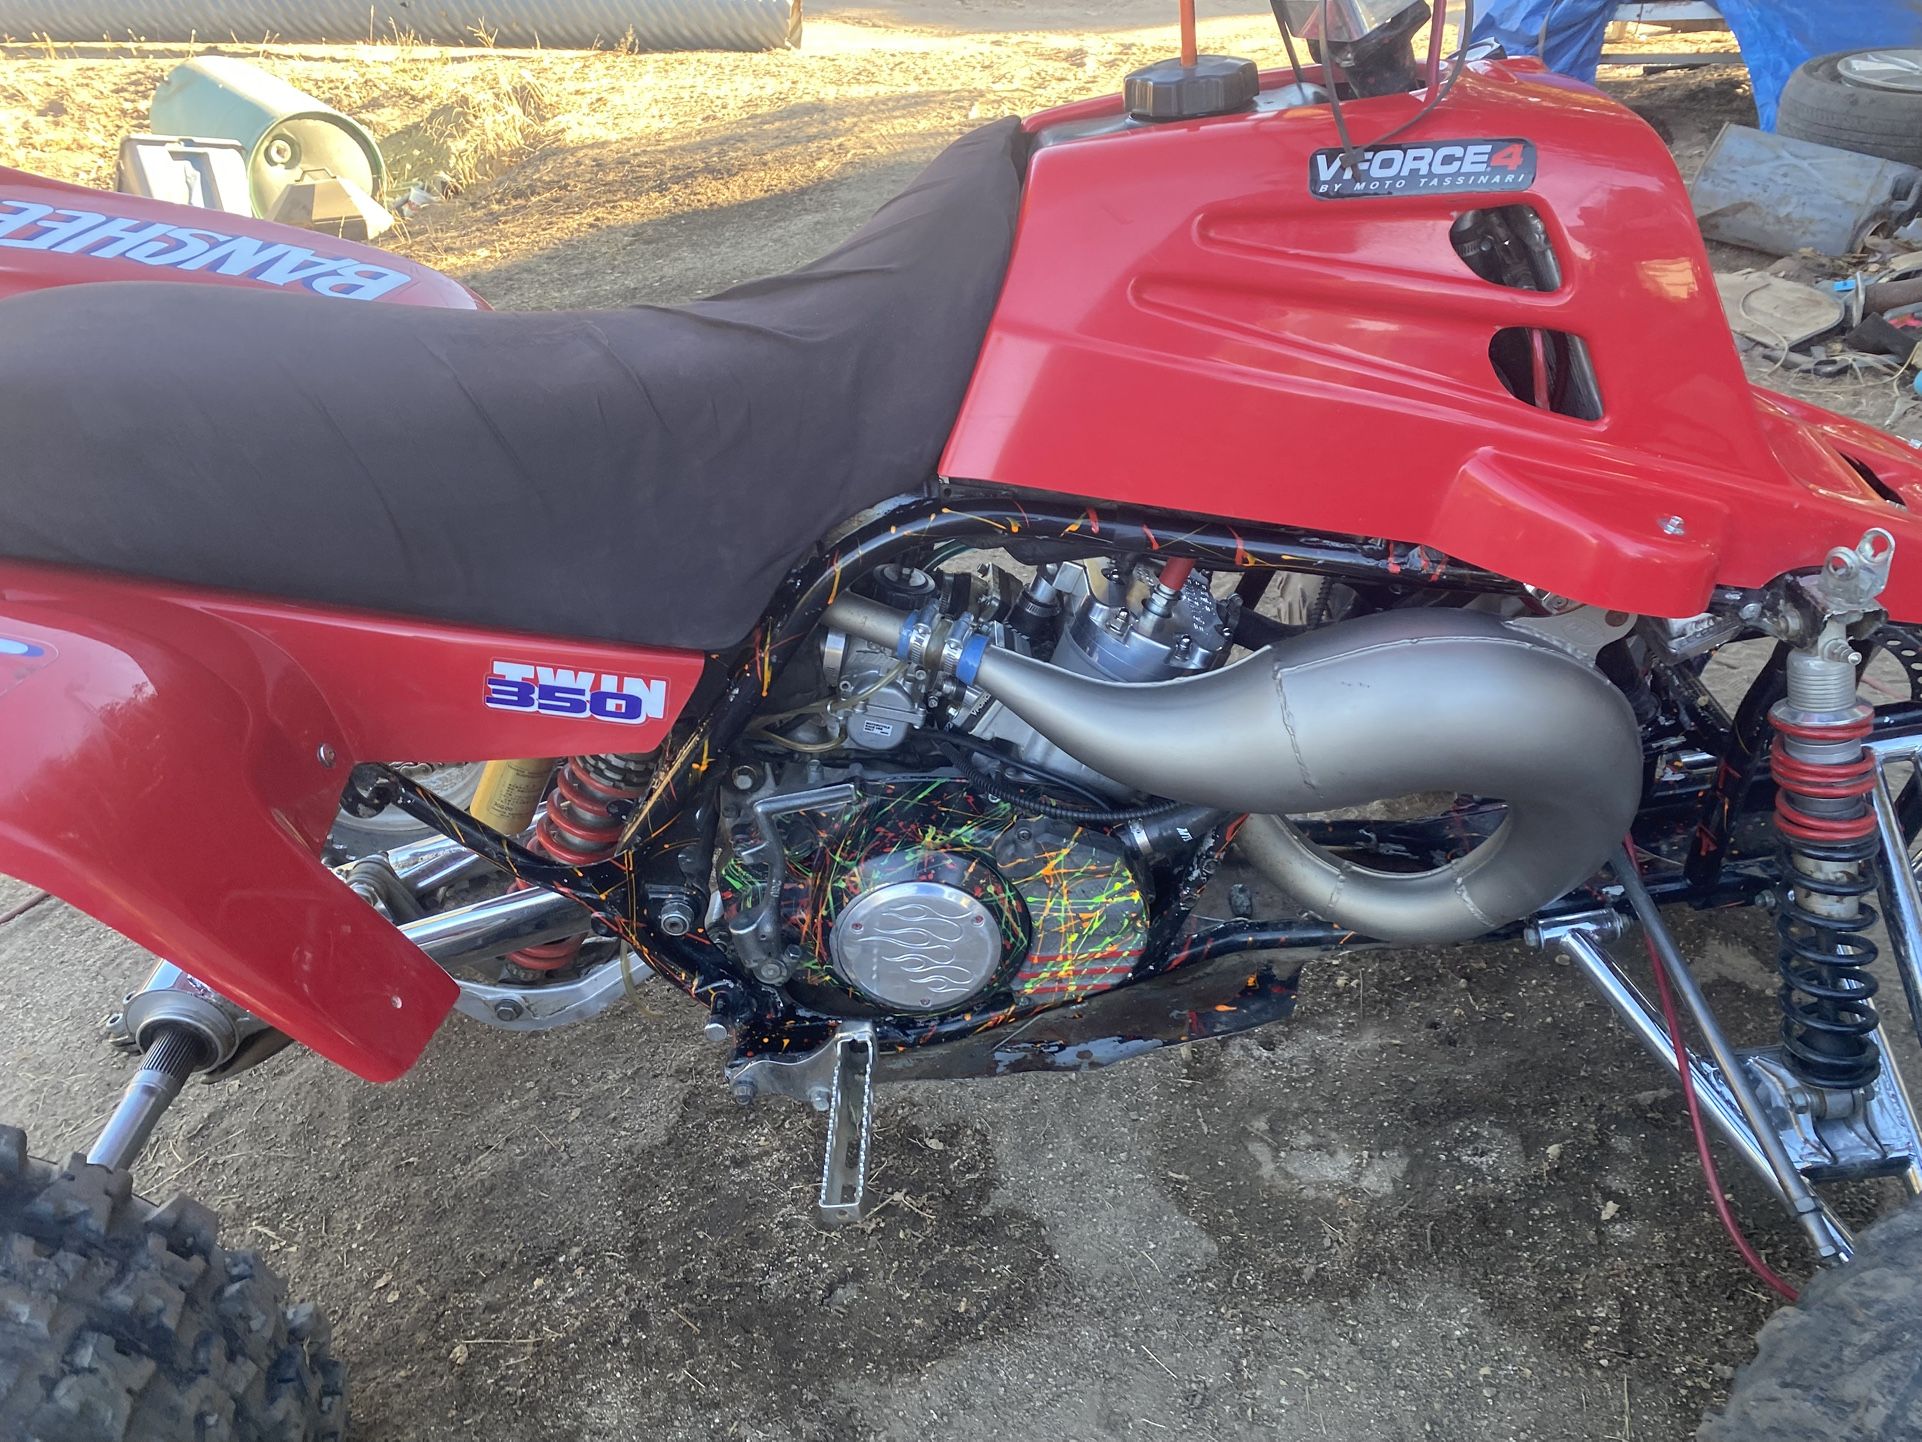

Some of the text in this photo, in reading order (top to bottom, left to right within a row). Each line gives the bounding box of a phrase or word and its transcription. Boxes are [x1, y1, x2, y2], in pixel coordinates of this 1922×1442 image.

[1318, 173, 1526, 193] BY MOTO TASSINARI
[485, 677, 646, 725] 350
[493, 660, 667, 719] TWIN
